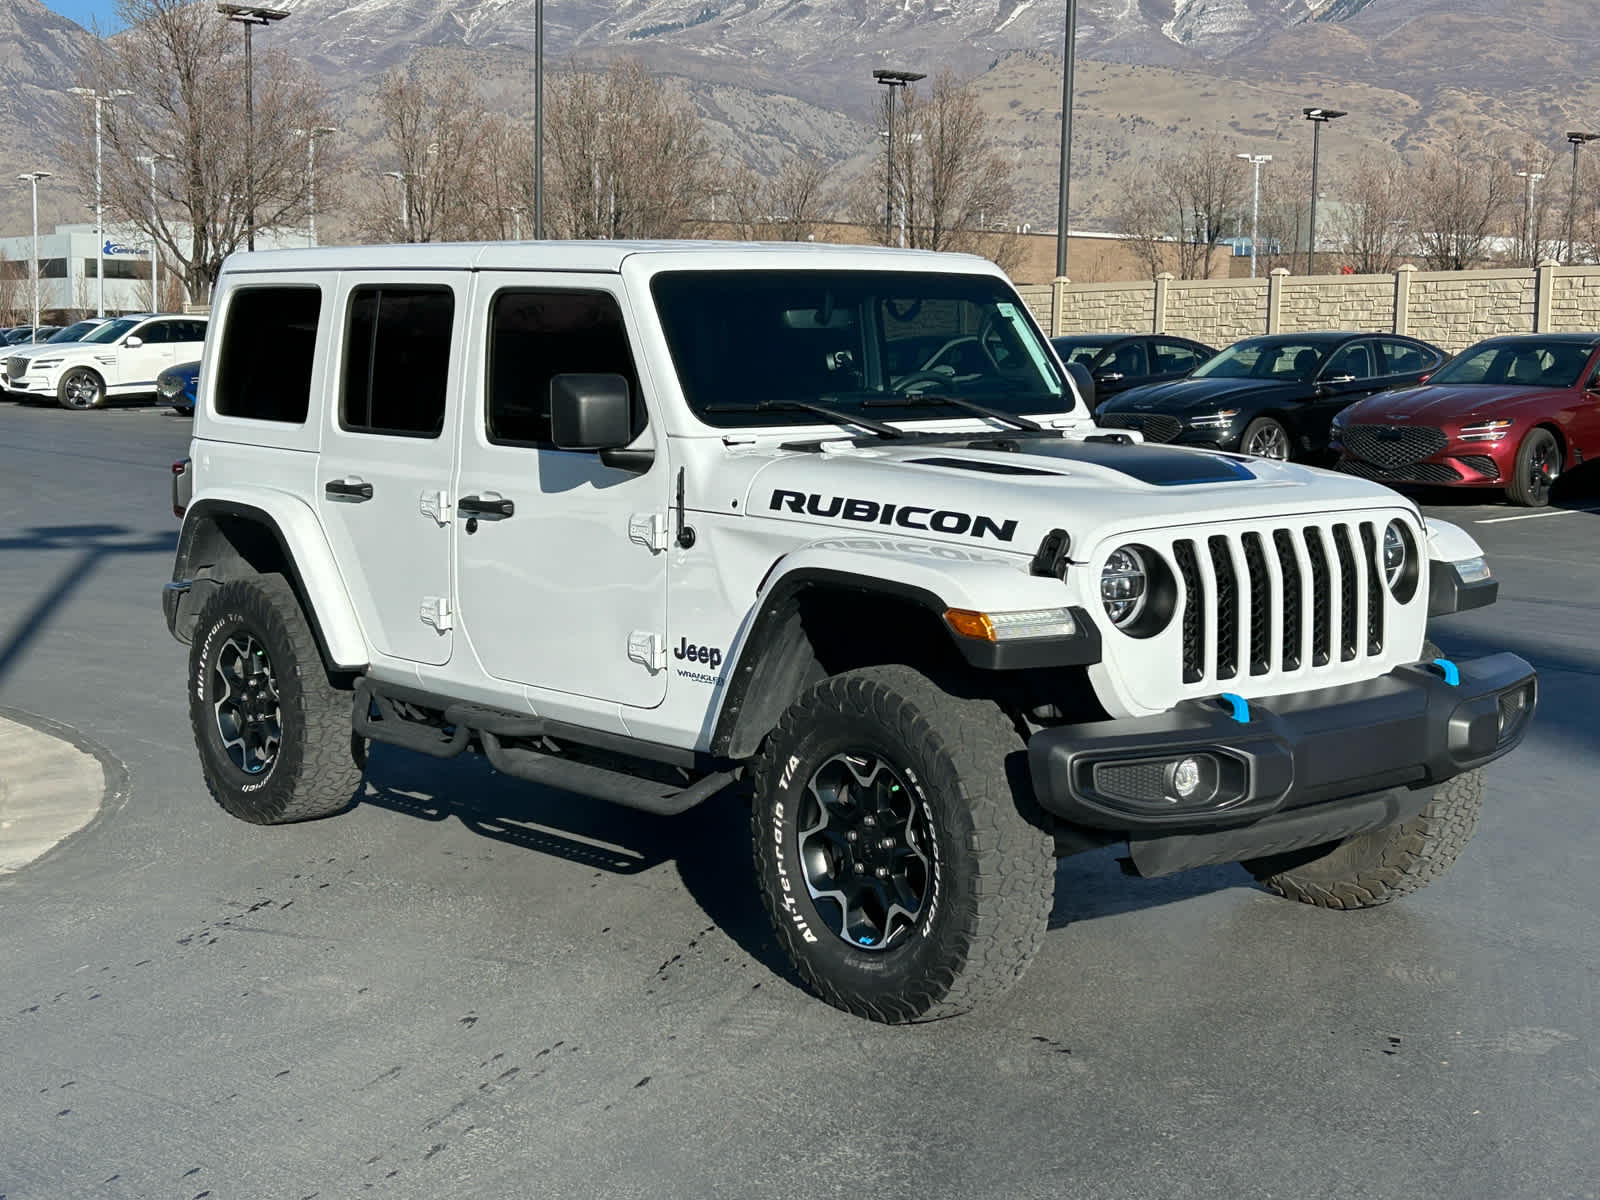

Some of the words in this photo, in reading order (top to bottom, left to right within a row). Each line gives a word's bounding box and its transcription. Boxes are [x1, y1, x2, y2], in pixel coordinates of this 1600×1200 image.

[769, 488, 1019, 542] RUBICON
[673, 636, 722, 670] Jeep
[778, 754, 800, 790] T/A
[773, 801, 818, 943] All-Terrain
